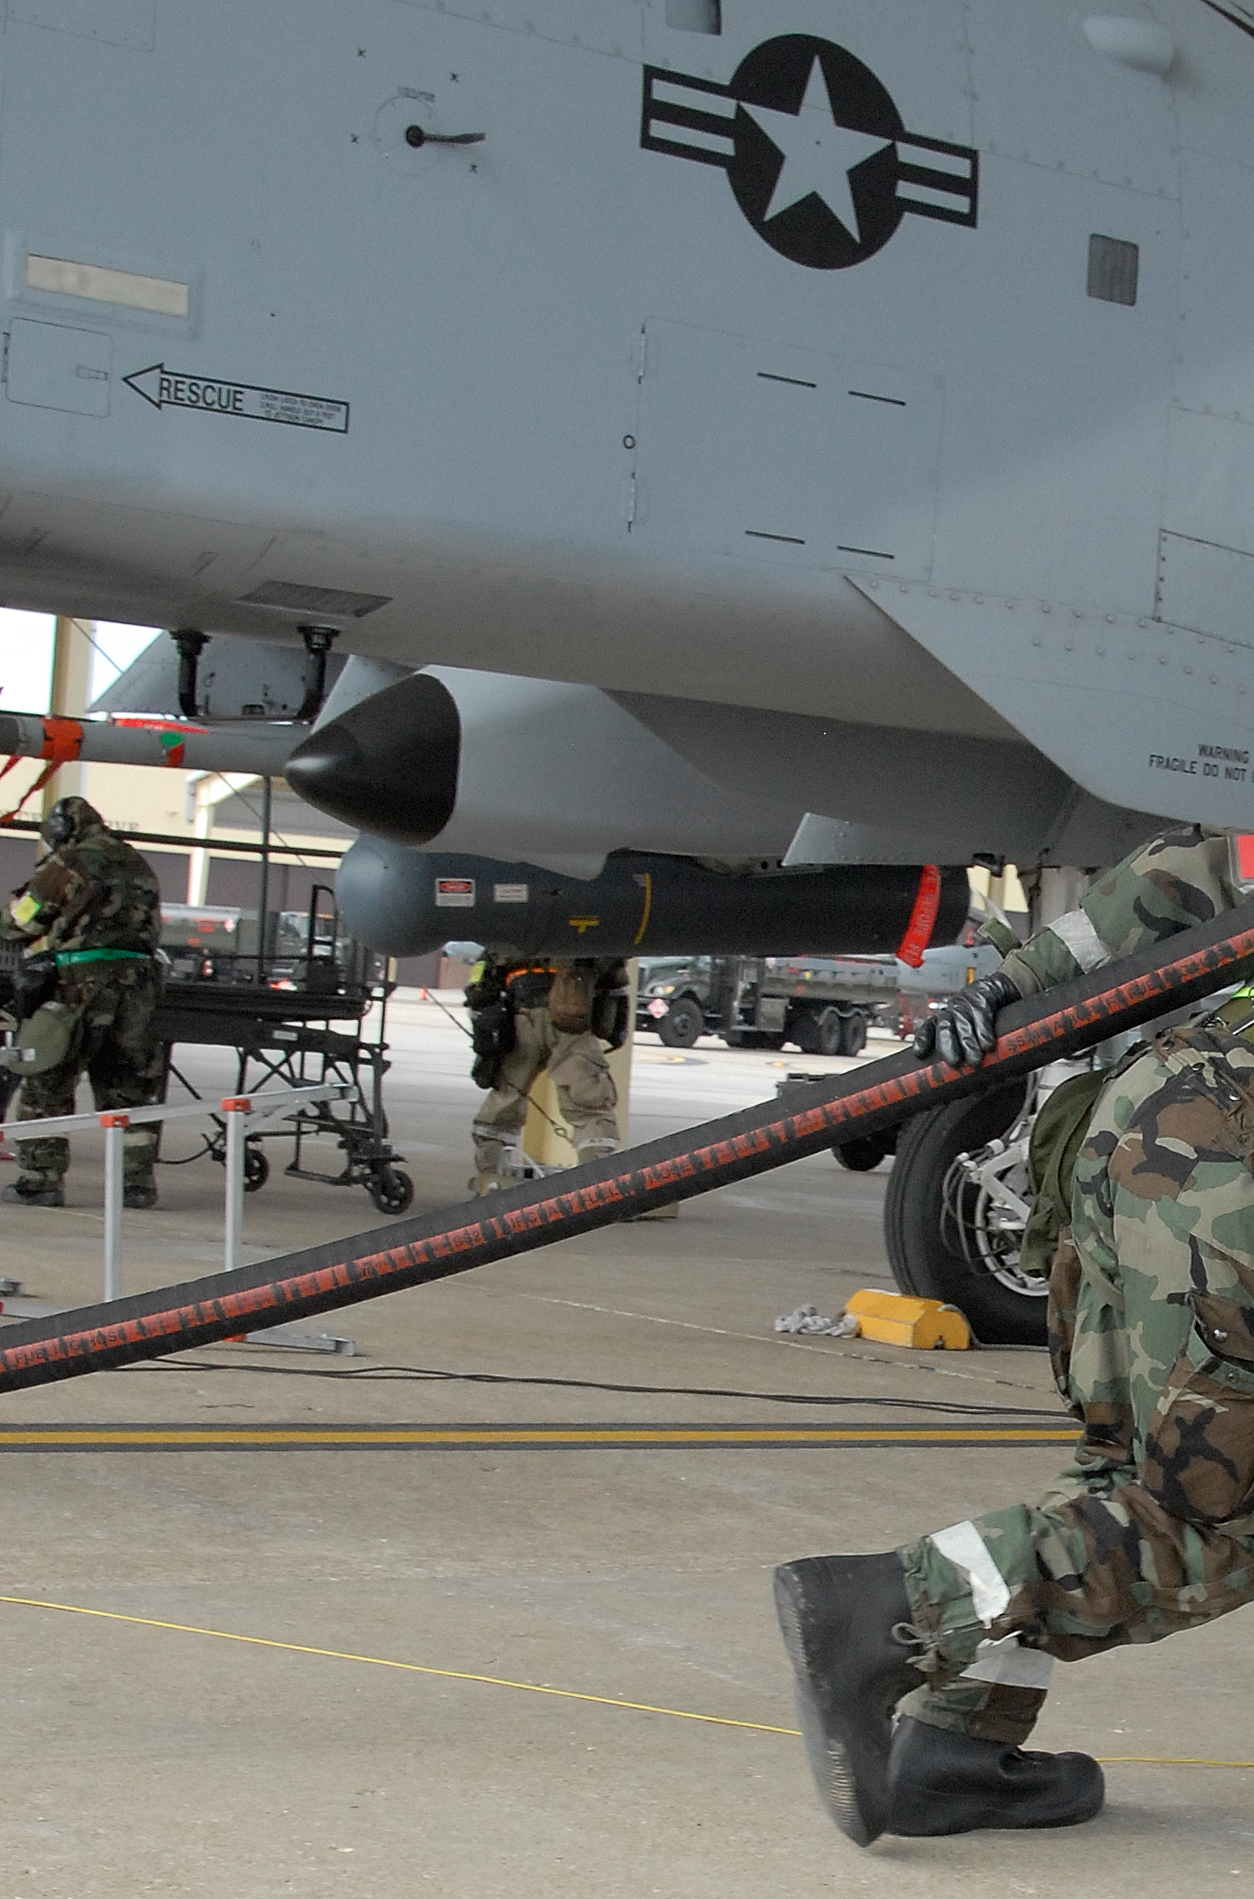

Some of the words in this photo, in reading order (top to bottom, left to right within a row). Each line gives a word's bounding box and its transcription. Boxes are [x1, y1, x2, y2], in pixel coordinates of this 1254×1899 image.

[159, 377, 244, 412] RESCUE
[1149, 754, 1198, 775] FRAGILE
[1203, 762, 1220, 778] DO
[1225, 766, 1248, 782] NOT
[1199, 744, 1250, 765] WARNING
